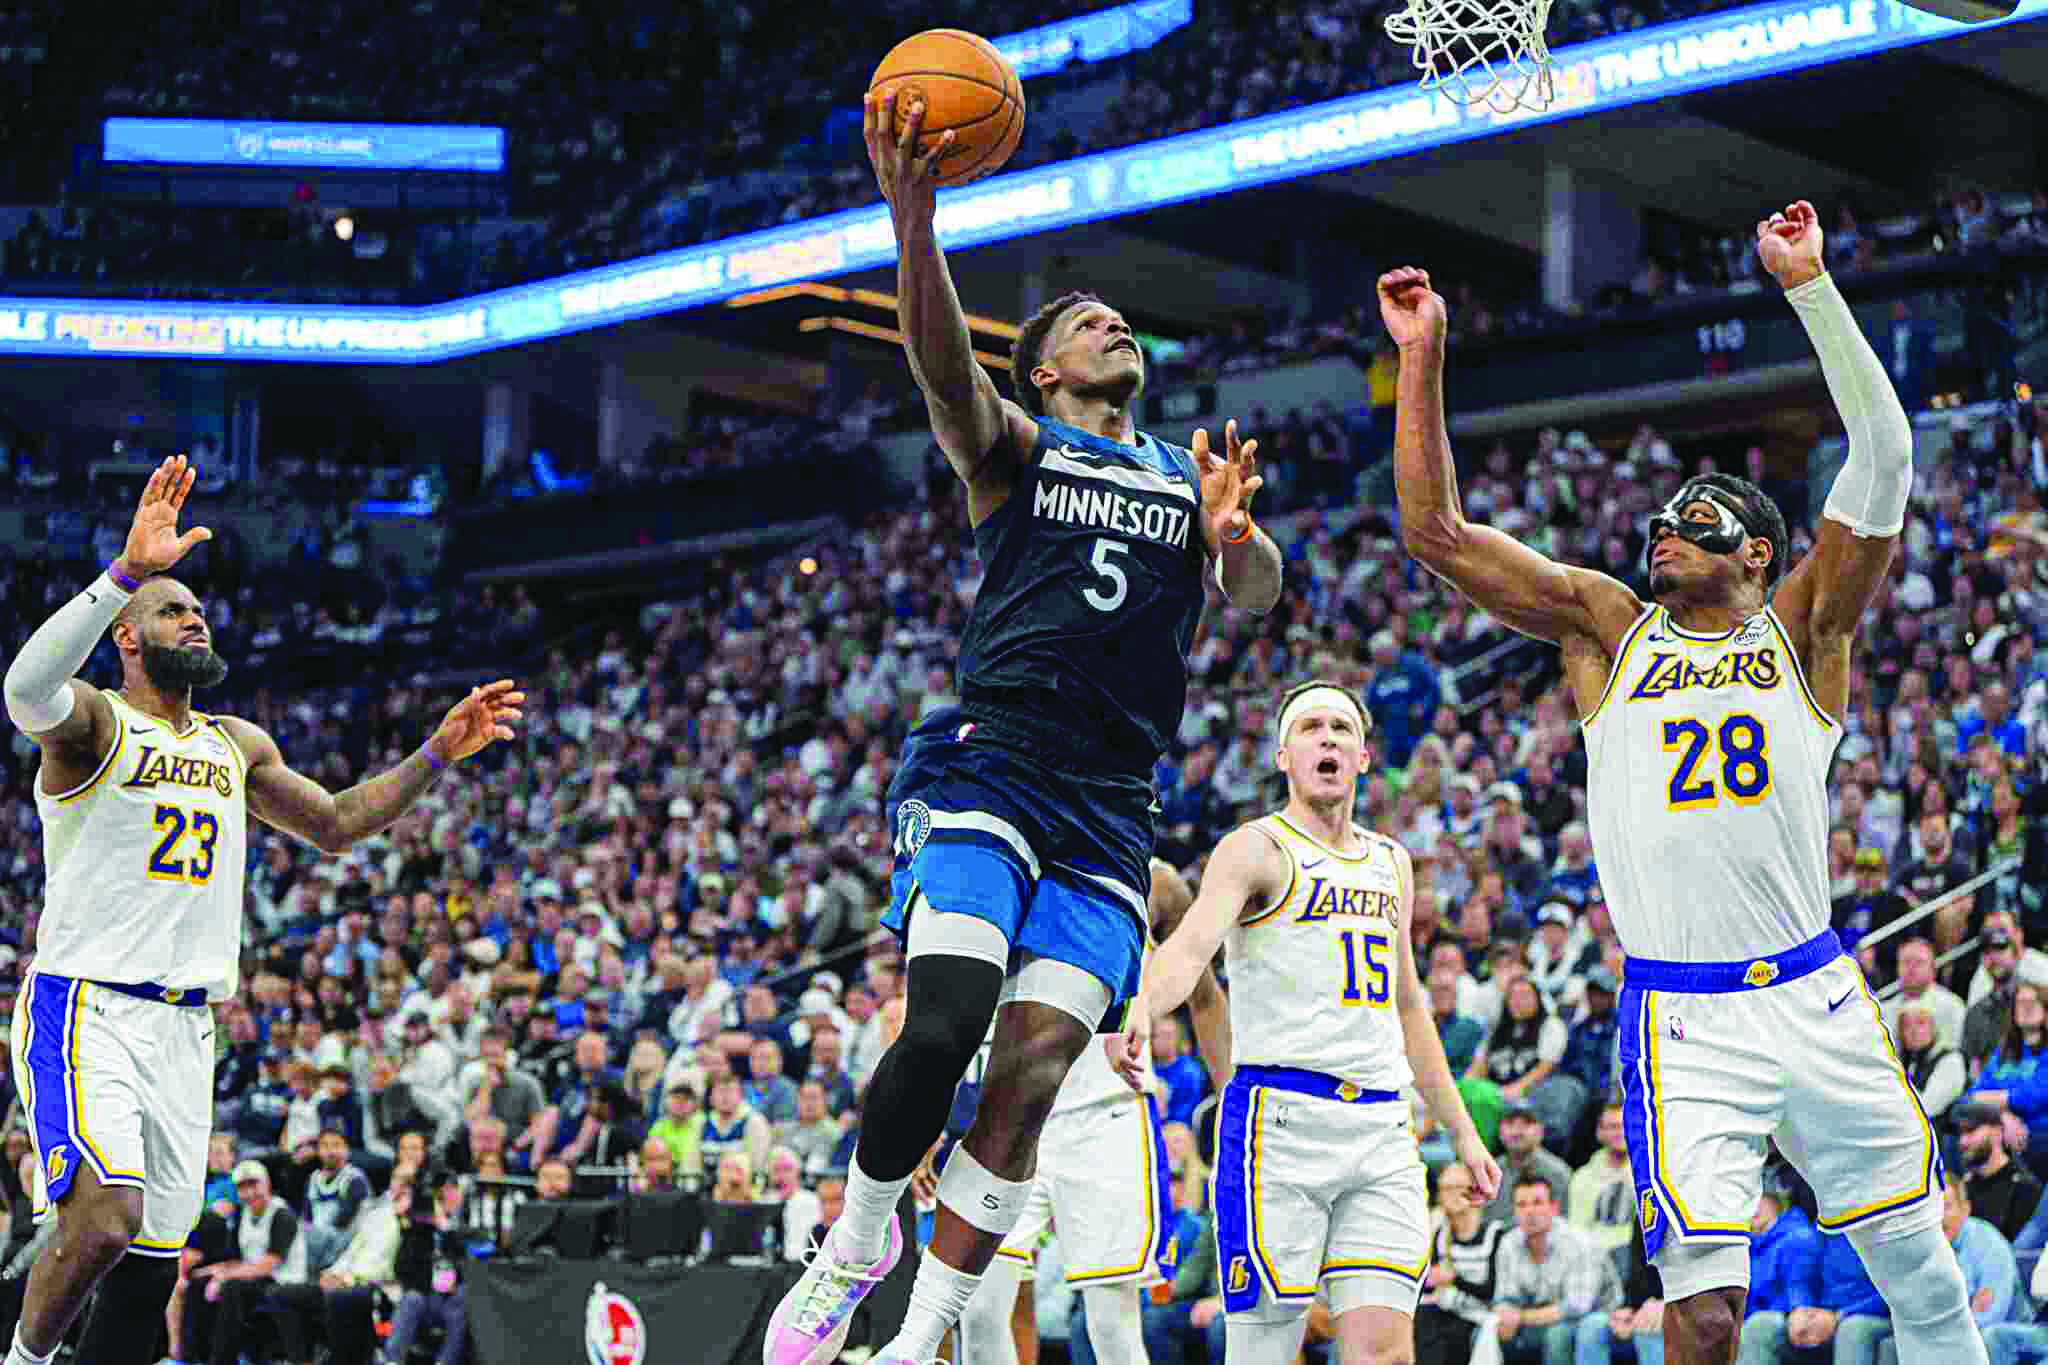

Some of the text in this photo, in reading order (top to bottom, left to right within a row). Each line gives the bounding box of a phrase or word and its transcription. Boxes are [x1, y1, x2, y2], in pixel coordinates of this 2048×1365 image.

[1033, 479, 1191, 550] MINNESOTA
[1083, 537, 1129, 612] 5
[1629, 648, 1781, 702] LAKERS
[120, 744, 232, 797] LAKERS
[1662, 713, 1771, 808] 28
[147, 803, 219, 882] 23
[1295, 877, 1399, 929] LAKERS
[1339, 929, 1391, 1006] 15
[981, 1192, 1001, 1211] 5
